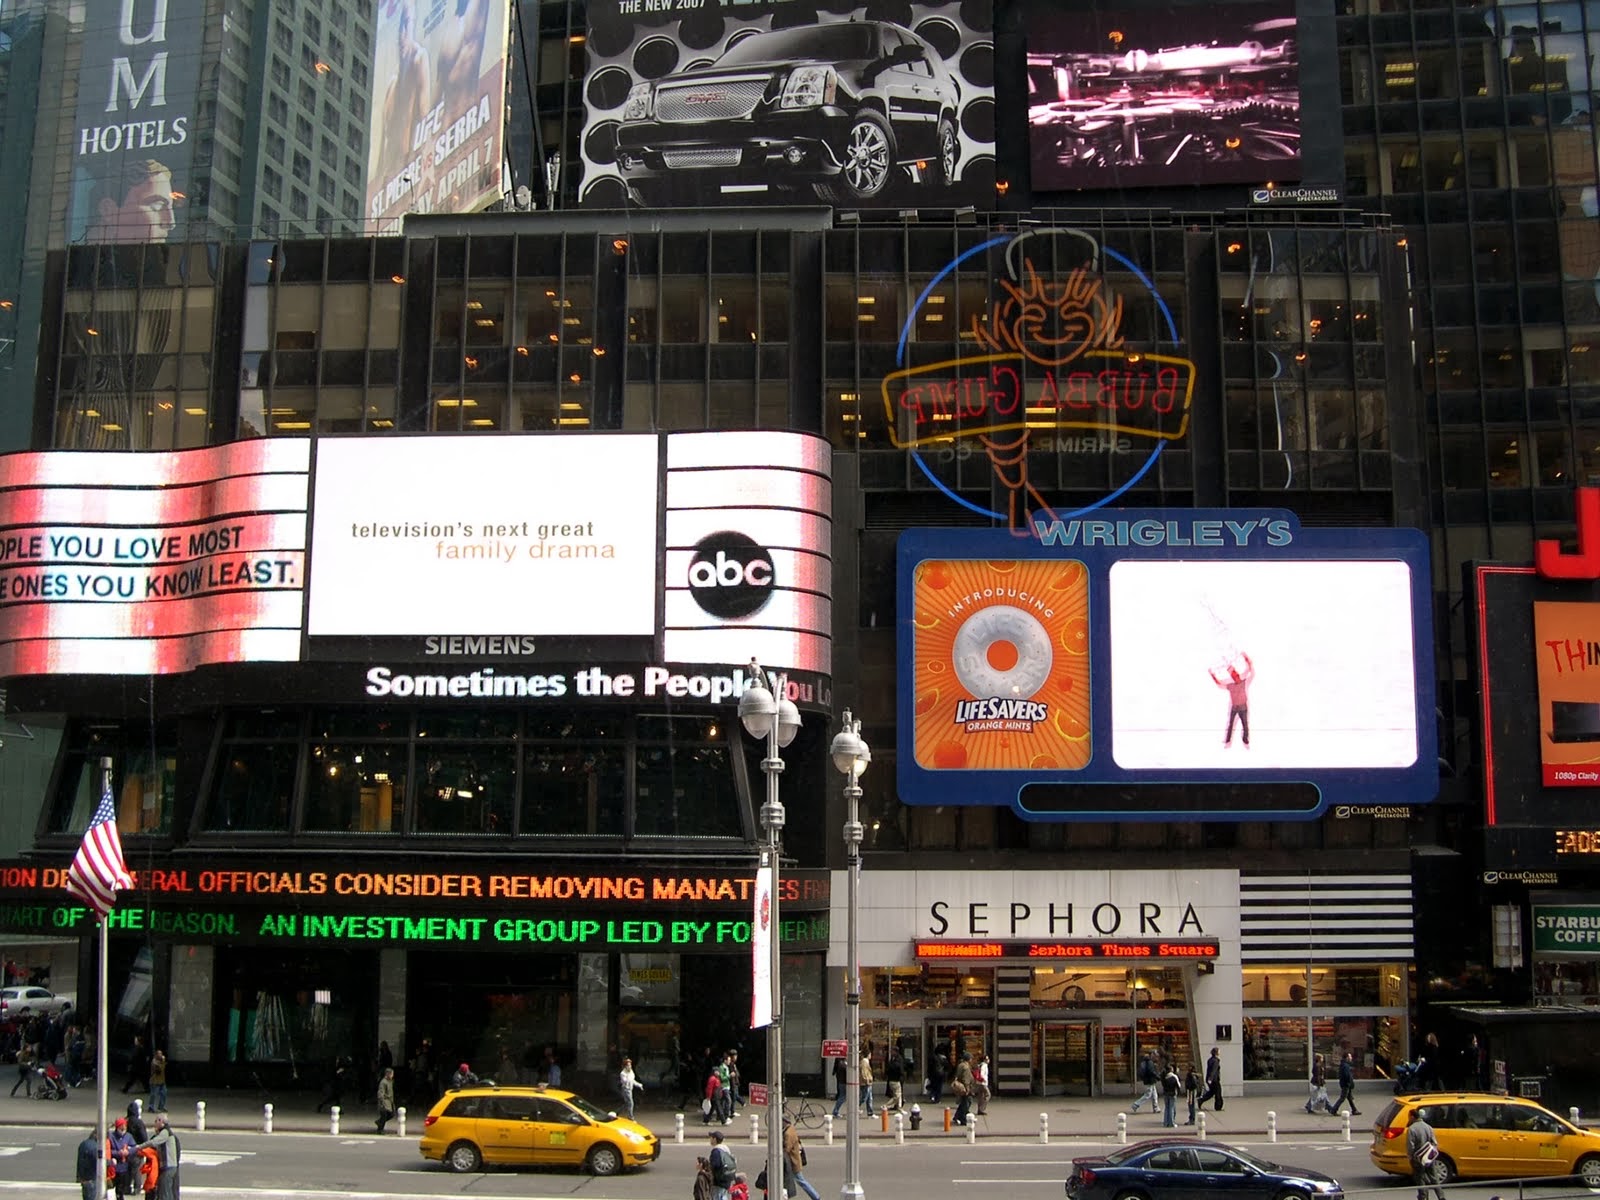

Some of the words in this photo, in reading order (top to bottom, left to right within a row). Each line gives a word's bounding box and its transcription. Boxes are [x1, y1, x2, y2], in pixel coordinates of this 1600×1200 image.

[619, 0, 641, 14] THE
[645, 0, 672, 12] NEW
[79, 117, 188, 155] HOTELS
[413, 101, 445, 152] UFC
[434, 94, 491, 167] SERRA
[437, 148, 481, 205] APRIL
[484, 136, 494, 166] 7
[50, 535, 104, 558] YOU
[114, 534, 182, 558] LOVE
[188, 526, 244, 557] MOST
[351, 522, 473, 538] television's
[483, 522, 528, 537] next
[538, 522, 594, 540] great
[1034, 518, 1293, 547] WRIGLEY'S
[436, 541, 517, 562] family
[529, 541, 615, 559] drama
[12, 574, 68, 598] ONES
[76, 575, 134, 598] YOU
[146, 568, 203, 597] KNOW
[208, 560, 295, 587] LEAST.
[689, 551, 773, 588] abc
[948, 588, 1055, 618] INTRODUCING
[425, 636, 536, 655] SIEMENS
[366, 667, 567, 697] Sometimes
[574, 667, 635, 696] the
[644, 667, 752, 704] Peopl
[967, 721, 1003, 731] ORANGE
[1006, 721, 1031, 731] MINTS
[1555, 772, 1576, 780] 1080p
[1578, 772, 1599, 780] Clarity
[199, 872, 327, 893] OFFICIALS
[334, 873, 482, 897] CONSIDER
[490, 876, 645, 899] REMOVING
[53, 907, 86, 928] OF
[89, 908, 144, 929] HE
[260, 914, 296, 936] AN
[303, 915, 488, 940] INVESTMENT
[494, 918, 600, 942] GROUP
[607, 920, 663, 943] LED
[671, 921, 710, 943] BY
[930, 902, 1203, 935] SEPHORA
[1029, 945, 1093, 956] Sephora
[1102, 945, 1150, 956] Times
[1159, 945, 1214, 957] Square
